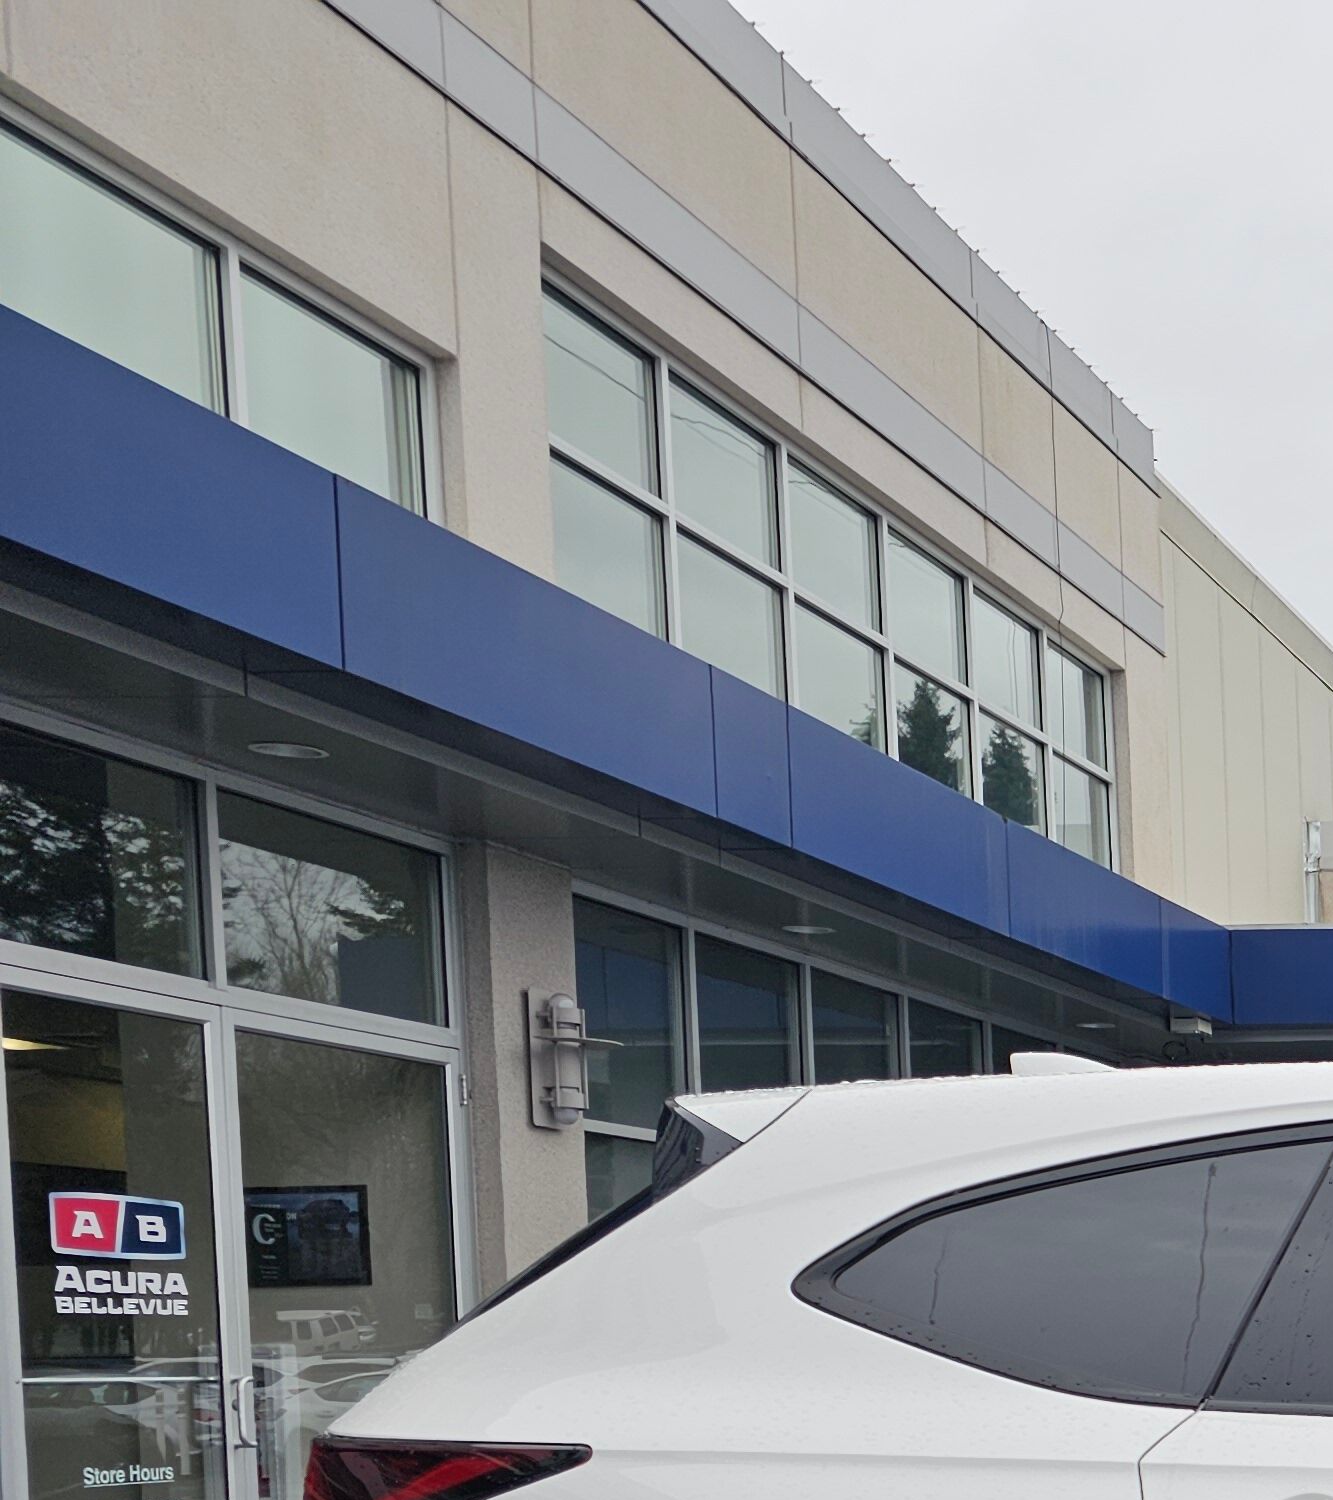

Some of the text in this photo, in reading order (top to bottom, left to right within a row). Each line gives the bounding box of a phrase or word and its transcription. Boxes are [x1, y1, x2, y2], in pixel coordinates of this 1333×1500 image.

[72, 1210, 167, 1242] A B
[54, 1265, 189, 1296] ACURA
[54, 1296, 189, 1316] BELLEVUE
[83, 1464, 175, 1484] Store Hours
